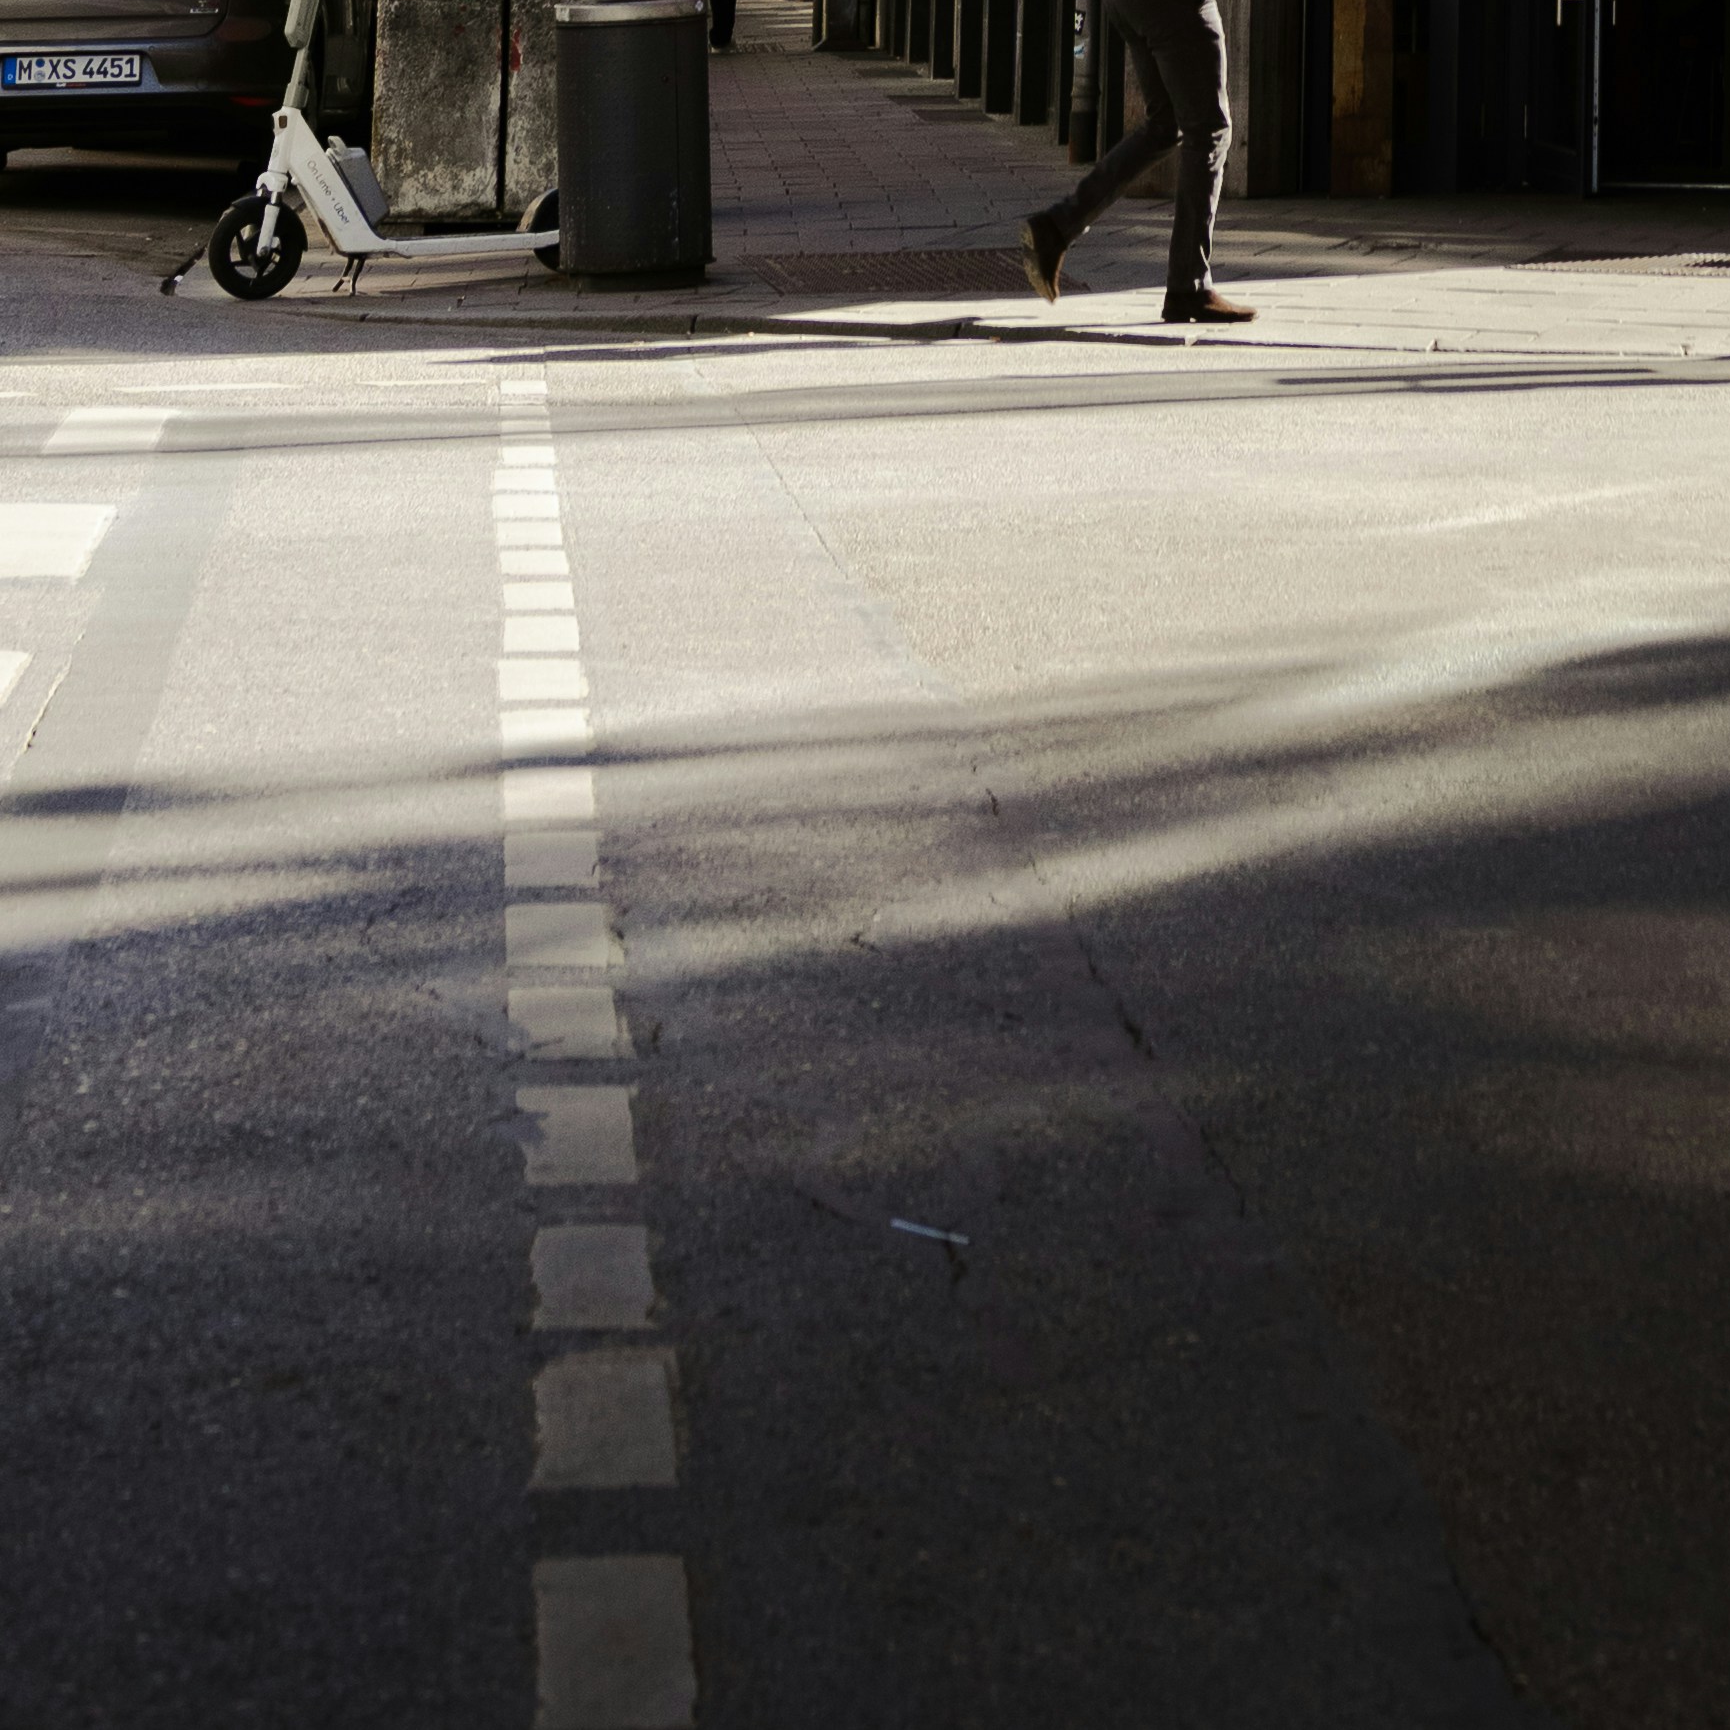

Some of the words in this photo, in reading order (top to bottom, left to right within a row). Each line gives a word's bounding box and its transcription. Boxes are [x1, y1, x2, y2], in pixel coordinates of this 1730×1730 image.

[17, 58, 33, 81] M
[47, 57, 77, 81] XS
[81, 56, 138, 80] 4451
